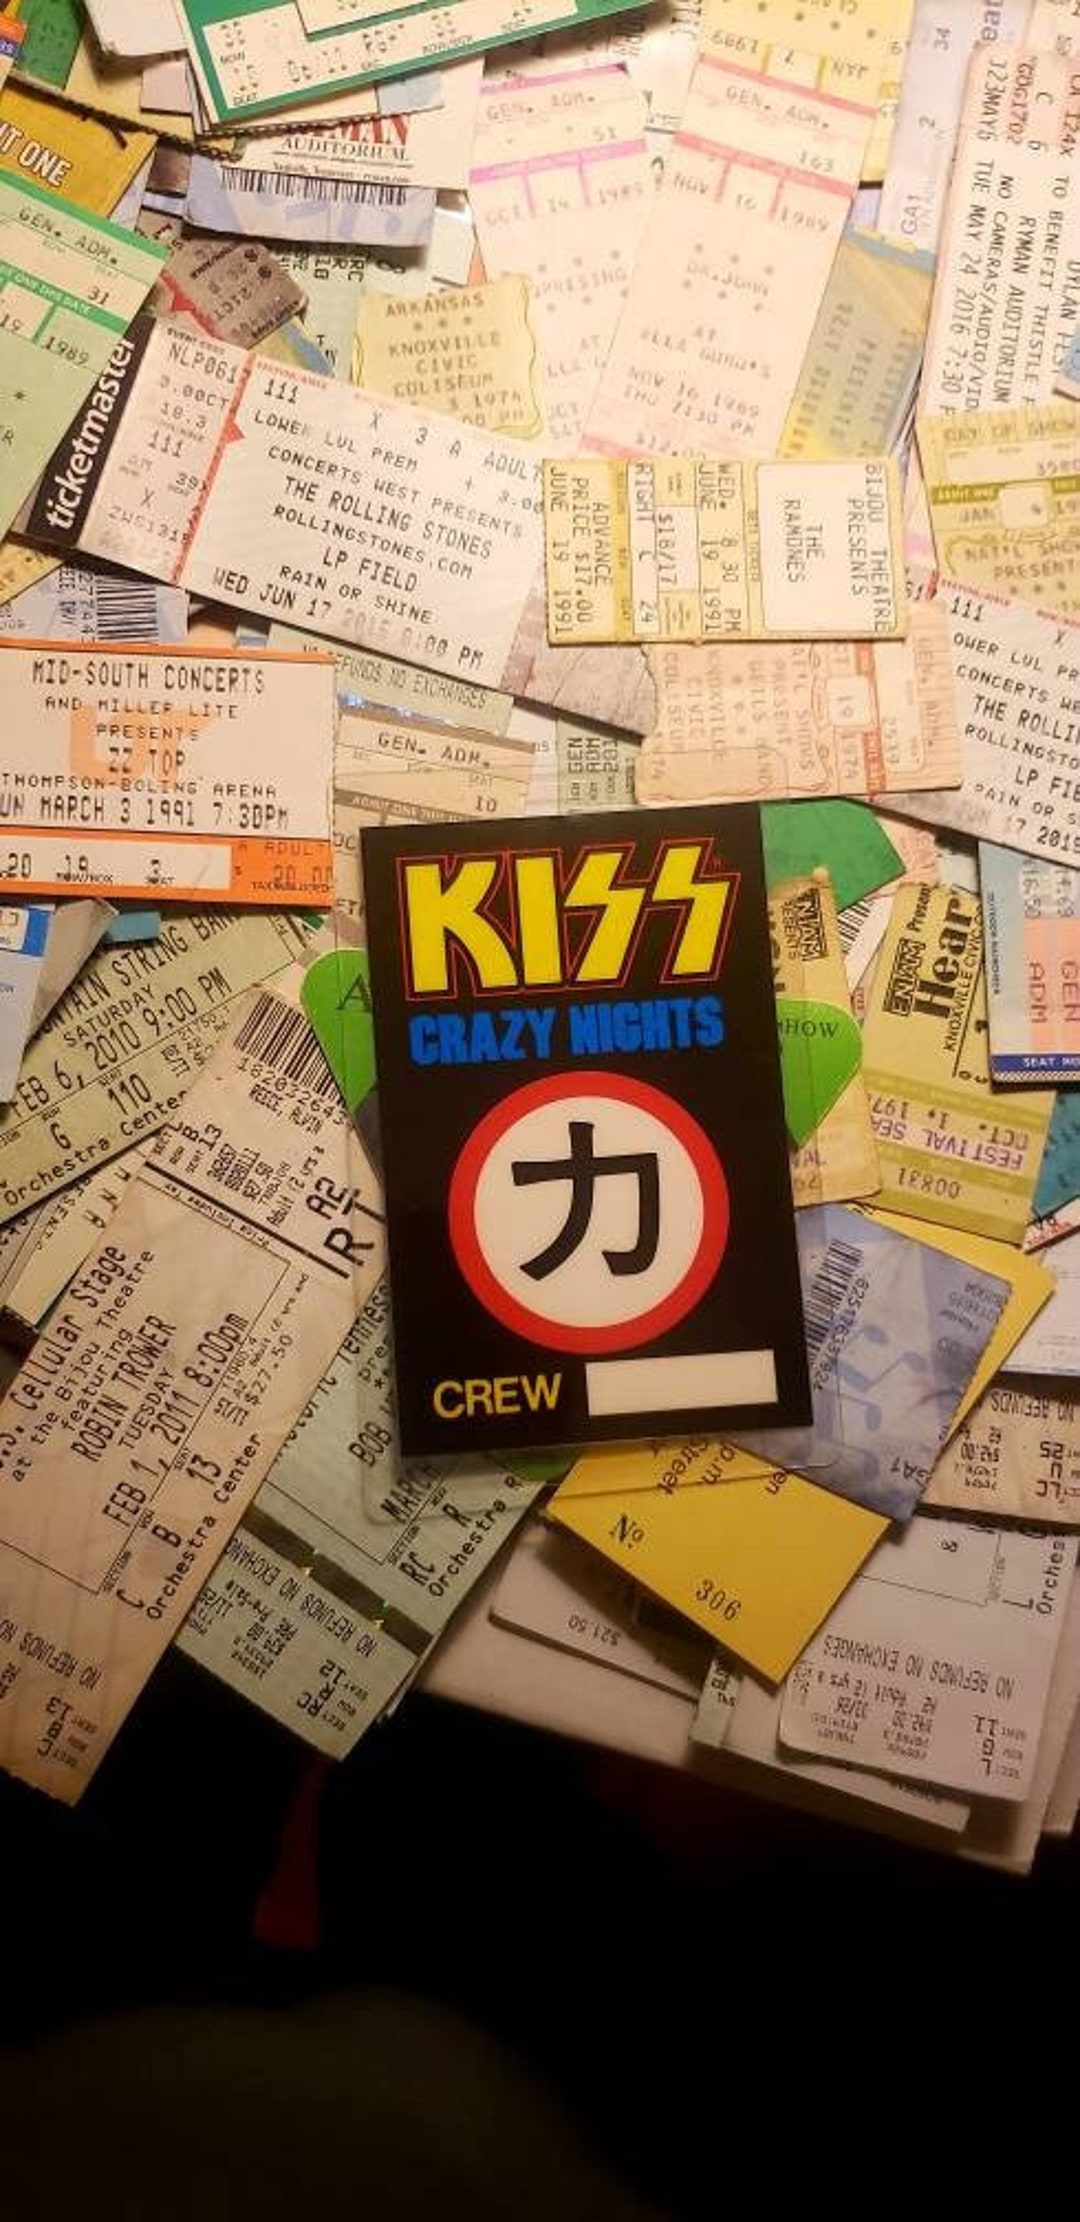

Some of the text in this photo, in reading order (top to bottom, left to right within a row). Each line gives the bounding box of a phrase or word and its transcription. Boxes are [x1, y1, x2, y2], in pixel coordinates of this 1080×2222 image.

[725, 85, 830, 129] GEN. ADM.
[19, 141, 72, 188] ONE
[997, 174, 1015, 200] NO
[18, 209, 118, 267] GEN. ADM.
[88, 284, 110, 307] 31
[941, 159, 995, 396] TUE MAY 24 2016 7:30
[1023, 174, 1070, 384] TO BENEFIT THISTLE
[385, 292, 486, 318] ARKANSAS
[993, 214, 1038, 404] RYMAN AUDITORIUM
[388, 330, 502, 356] KNOXVILLE
[414, 354, 479, 375] CIVIC
[263, 379, 301, 406] 111
[393, 372, 496, 399] COLISEUM
[45, 338, 137, 531] ticketmaster
[370, 446, 420, 473] PREM
[266, 443, 524, 540] CONCERTS WEST PRESENTS
[634, 461, 657, 524] RIGHT
[698, 463, 721, 513] JUNE
[284, 474, 493, 562] THE ROLLING STONES
[592, 500, 614, 587] ADVANCE
[782, 499, 807, 585] RAMONES
[805, 523, 826, 561] THE
[321, 546, 419, 595] LP FIELD
[549, 465, 575, 635] JUNE 19 1991
[571, 476, 595, 624] PRICE $17.00
[656, 512, 679, 586] $16/17
[699, 538, 720, 562] 19
[847, 499, 871, 597] PRESENTS
[864, 463, 893, 635] BIJOU THEATRE
[212, 565, 250, 597] WED
[258, 581, 299, 612] JUN
[457, 644, 486, 671] PM
[278, 564, 436, 626] RAIN OR SHINE
[702, 586, 723, 633] 1991
[725, 606, 743, 633] PM
[951, 597, 984, 623] 111
[32, 658, 266, 697] MID-SOUTH CONCERTS
[955, 663, 1050, 704] CONCERTS
[45, 695, 240, 720] AND MILLER LITE
[96, 723, 200, 742] PRESENTS
[973, 693, 1009, 722] THE
[108, 747, 187, 777] ZZ TOP
[377, 731, 491, 770] GEN. ADM.
[566, 736, 585, 774] GEN
[1, 772, 278, 799] THOMPSON-BOLING ARENA
[40, 797, 106, 822] MARCH
[119, 797, 132, 825] 3
[146, 800, 196, 828] 1991
[212, 802, 290, 832] 7:30PM
[399, 840, 739, 999] KISS
[111, 921, 189, 989] STRING
[912, 897, 974, 1020] Hear
[62, 984, 156, 1048] SATURDAY
[1028, 961, 1047, 1024] ADM
[1059, 961, 1080, 1023] GEN
[84, 965, 233, 1072] 2010 9:00 PM
[408, 995, 726, 1067] CRAZY NIGHTS
[107, 1071, 152, 1117] 110
[3, 1137, 111, 1208] Orchestra
[119, 1088, 189, 1137] Center
[925, 1129, 1024, 1171] FESTIVAL
[978, 1122, 1030, 1148] OCT.
[511, 1121, 660, 1283] 力
[897, 1166, 962, 1200] 00831
[9, 1245, 126, 1412] Cellular Stage
[11, 1250, 155, 1484] at the Bijou Theatre
[60, 1326, 134, 1433] featuring
[70, 1314, 178, 1464] ROBIN TROWER
[101, 1480, 149, 1528] FEB
[149, 1389, 201, 1448] 2011
[183, 1311, 251, 1389] 8:00pm
[117, 1367, 175, 1451] TUESDAY
[432, 1372, 563, 1420] CREW
[346, 1418, 393, 1469] BOB
[116, 1334, 295, 1612] C B 13 $27.50
[145, 1513, 217, 1621] Orchestra
[212, 1431, 265, 1505] Center
[427, 1496, 508, 1599] Orchestra
[398, 1547, 440, 1587] RC
[276, 1573, 381, 1661] NO REFUNDS NO
[695, 1578, 743, 1623] 306
[18, 1630, 80, 1682] REFUNDS
[316, 1657, 349, 1686] 12
[822, 1633, 902, 1675] EXCHANGES
[904, 1653, 925, 1680] NO
